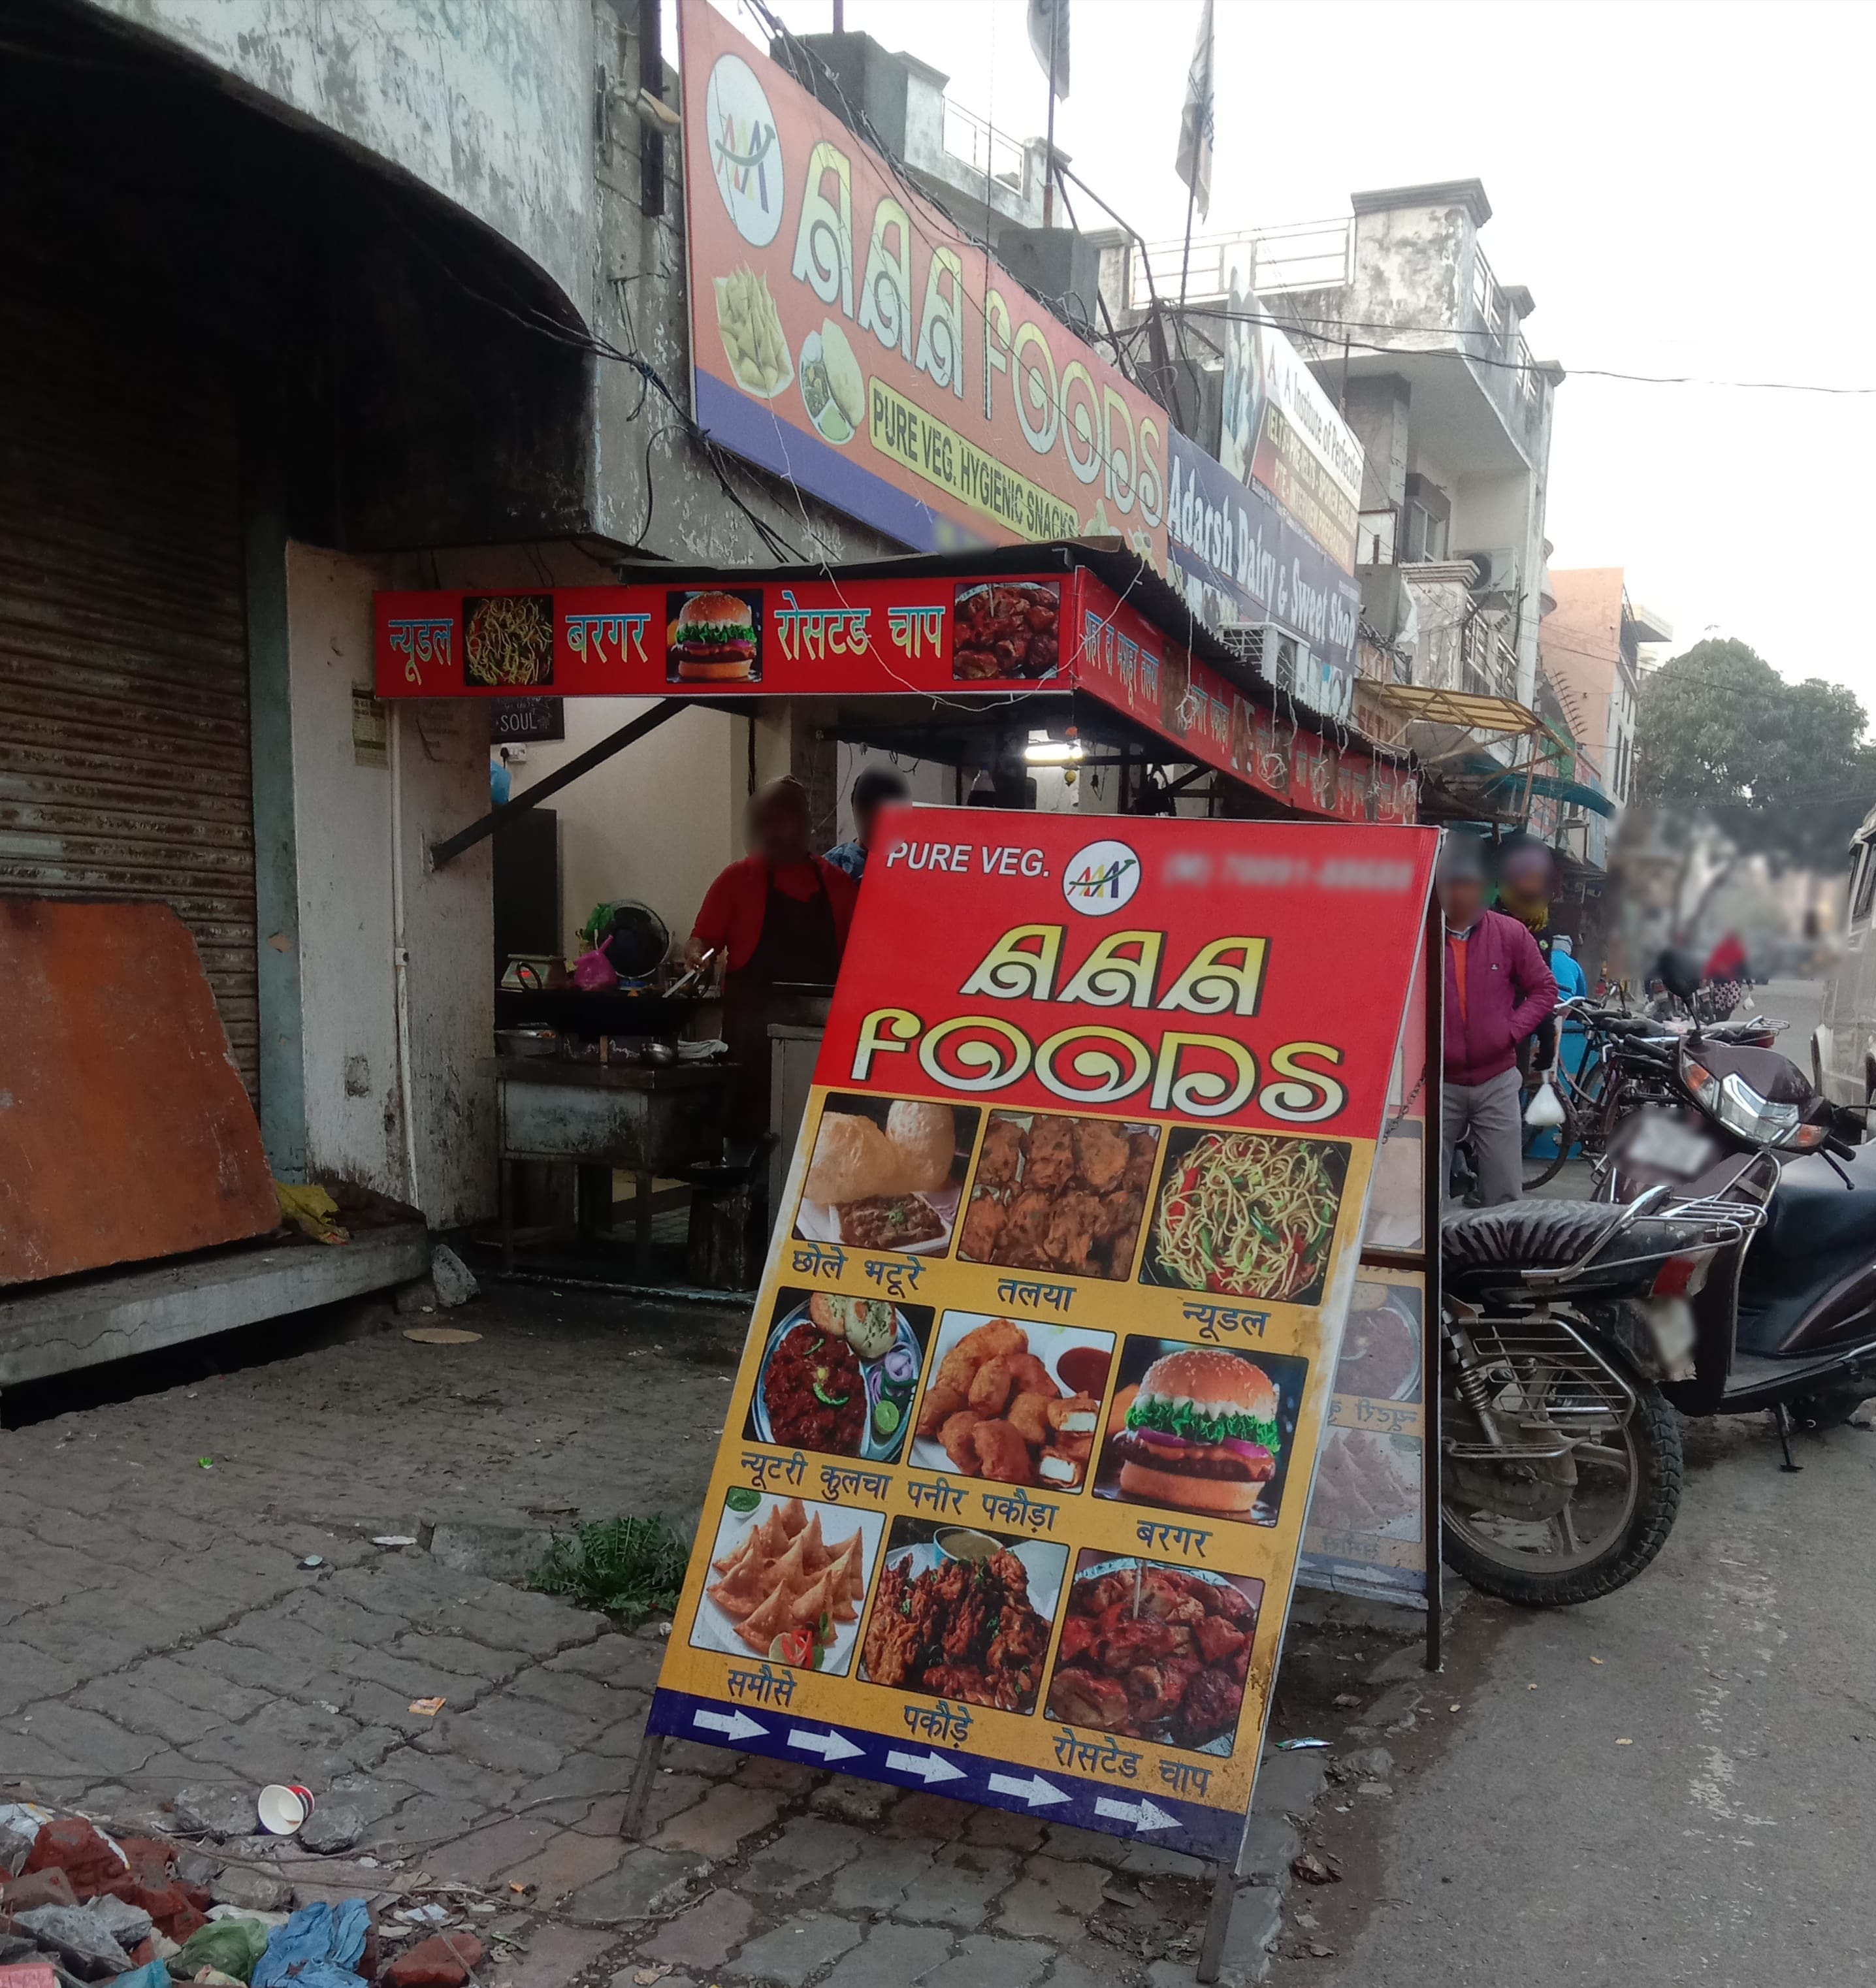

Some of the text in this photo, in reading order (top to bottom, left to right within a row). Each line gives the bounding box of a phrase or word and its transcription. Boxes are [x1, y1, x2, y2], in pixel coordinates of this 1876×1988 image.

[1294, 372, 1322, 445] Institute
[873, 388, 918, 462] PURE
[921, 420, 957, 487] VEG.
[961, 447, 1024, 525] HYGIENIC
[1168, 455, 1233, 579] Adarsh
[1237, 506, 1276, 622] Dairy
[1278, 564, 1288, 616] &
[1291, 557, 1328, 645] Sweet
[1329, 592, 1356, 662] Shop
[388, 590, 946, 685] न्यूडल बरगर रोसटड चाप
[500, 712, 537, 732] SOUL
[886, 841, 1050, 878] PURE VEG.
[959, 924, 1272, 1016] AAA
[850, 1008, 1346, 1123] FOODS
[792, 1243, 926, 1299] छोले भटूरे
[997, 1277, 1077, 1313] तलया
[1182, 1302, 1270, 1341] न्यूडल
[740, 1451, 894, 1502] न्यूटरी कुलचा
[907, 1477, 1060, 1533] पनीर पकौड़ा
[1136, 1520, 1214, 1559] बरगर
[727, 1664, 798, 1708] समौसे
[903, 1699, 974, 1750] पकौड़े
[1052, 1727, 1213, 1798] रोसटेड चाप
